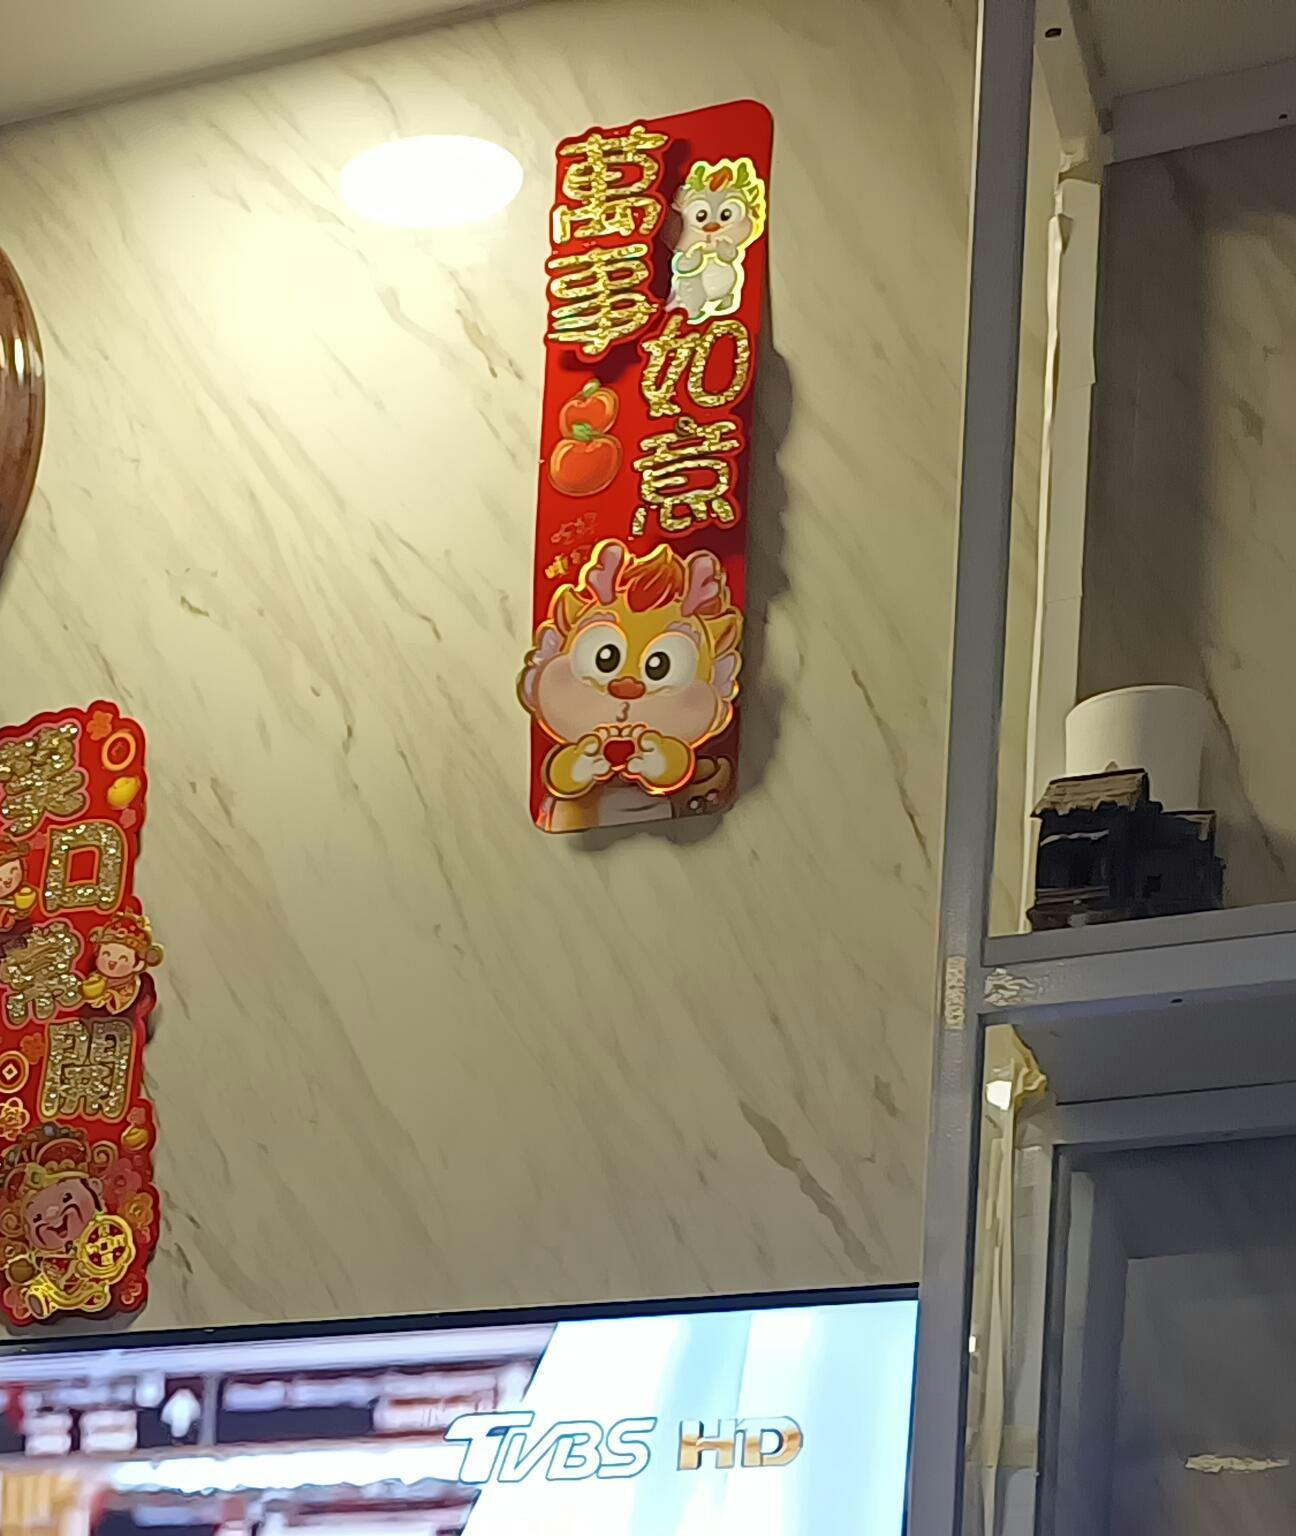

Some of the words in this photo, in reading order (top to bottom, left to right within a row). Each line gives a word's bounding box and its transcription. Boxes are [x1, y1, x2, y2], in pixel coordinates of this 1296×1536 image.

[548, 125, 670, 358] 萬事
[632, 318, 754, 538] 如意
[443, 1410, 658, 1485] TVBS
[676, 1414, 804, 1471] HD
